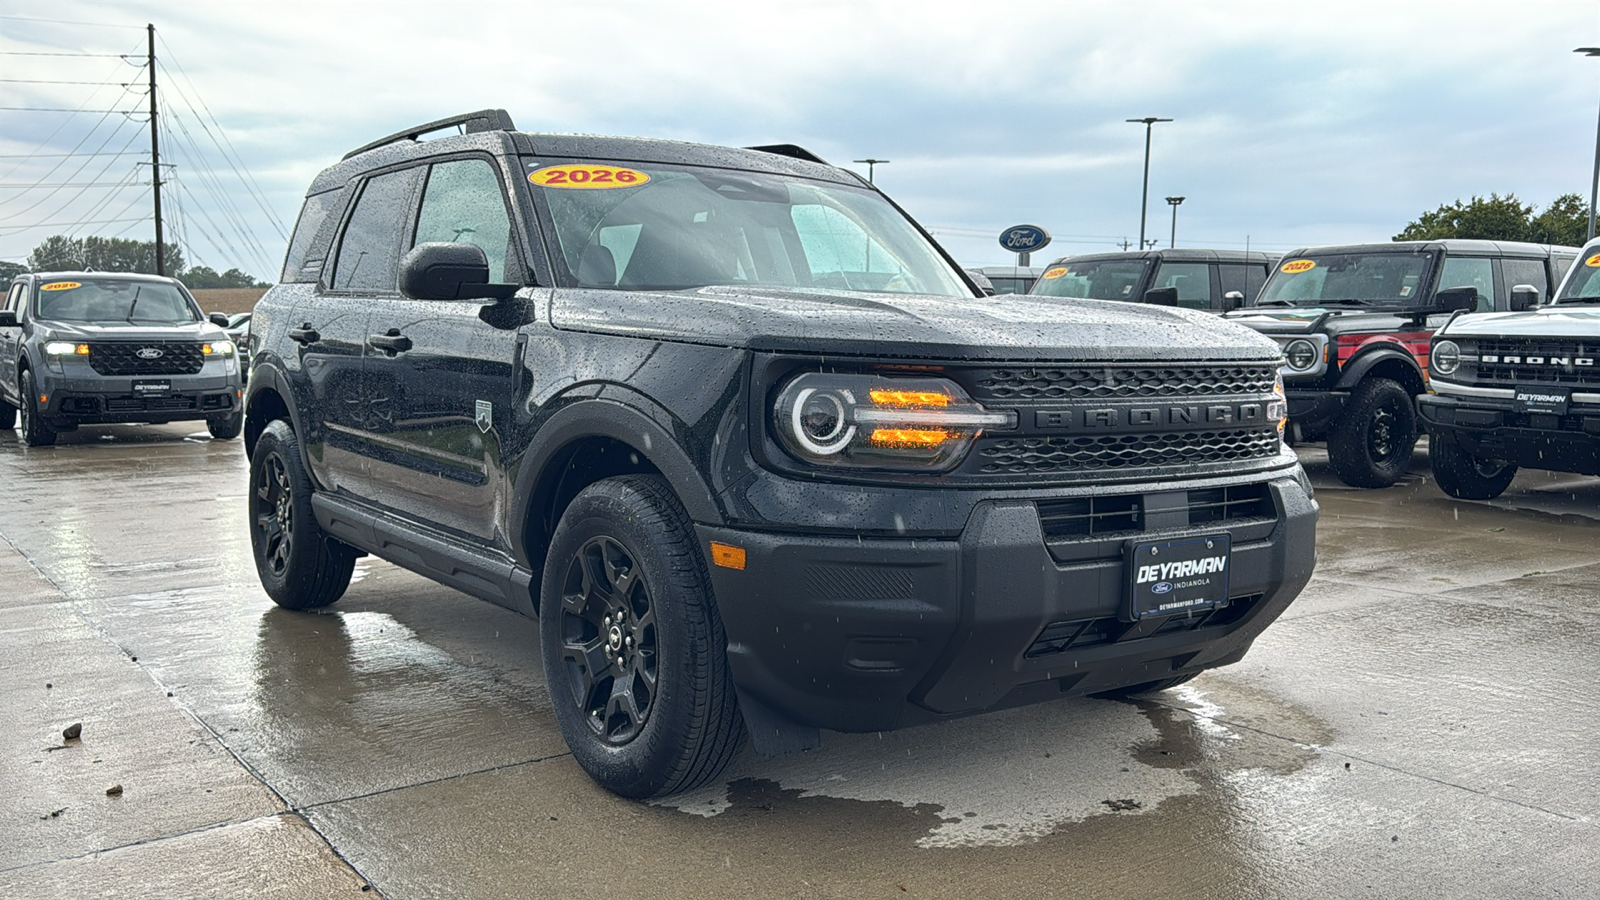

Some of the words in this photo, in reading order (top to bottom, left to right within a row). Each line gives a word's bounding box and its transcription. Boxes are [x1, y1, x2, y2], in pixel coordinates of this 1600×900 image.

[545, 169, 637, 184] 2026
[1007, 229, 1037, 247] Ford
[1282, 262, 1313, 271] 2026
[1481, 355, 1594, 366] BRONC
[1516, 393, 1566, 402] DEYARMAN
[1035, 403, 1261, 429] BRONCO
[1137, 556, 1226, 584] DEYARMAN
[1174, 578, 1210, 589] INDIANOLA
[1159, 598, 1204, 611] DEYARMANFORD.COM
